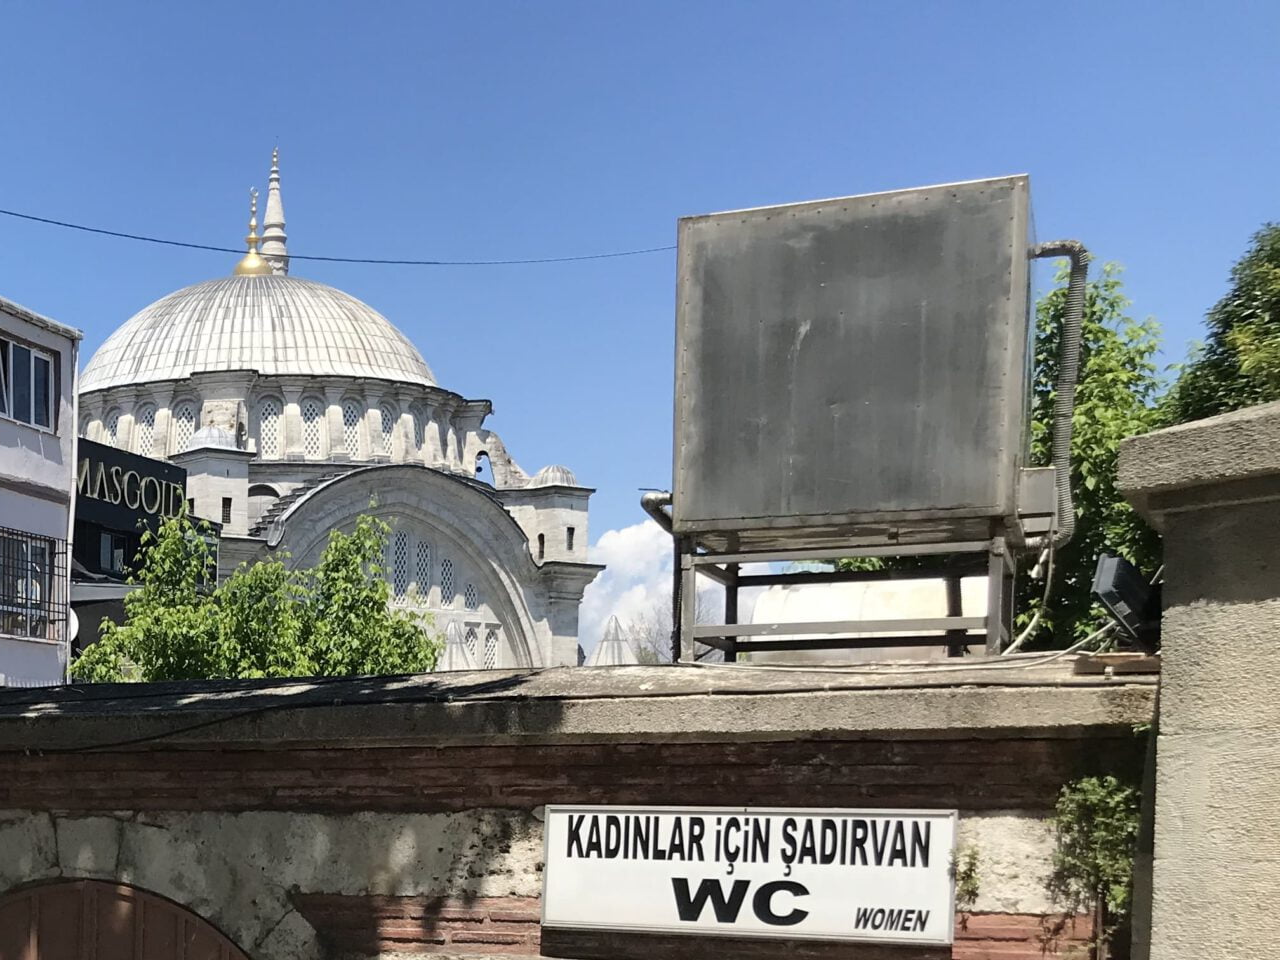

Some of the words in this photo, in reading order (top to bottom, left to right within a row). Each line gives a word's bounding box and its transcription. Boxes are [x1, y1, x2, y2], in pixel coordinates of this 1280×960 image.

[566, 814, 706, 862] KADINLAR
[780, 817, 932, 878] ŞADIRVAN
[671, 877, 811, 926] WC
[854, 907, 930, 933] WOMEN
